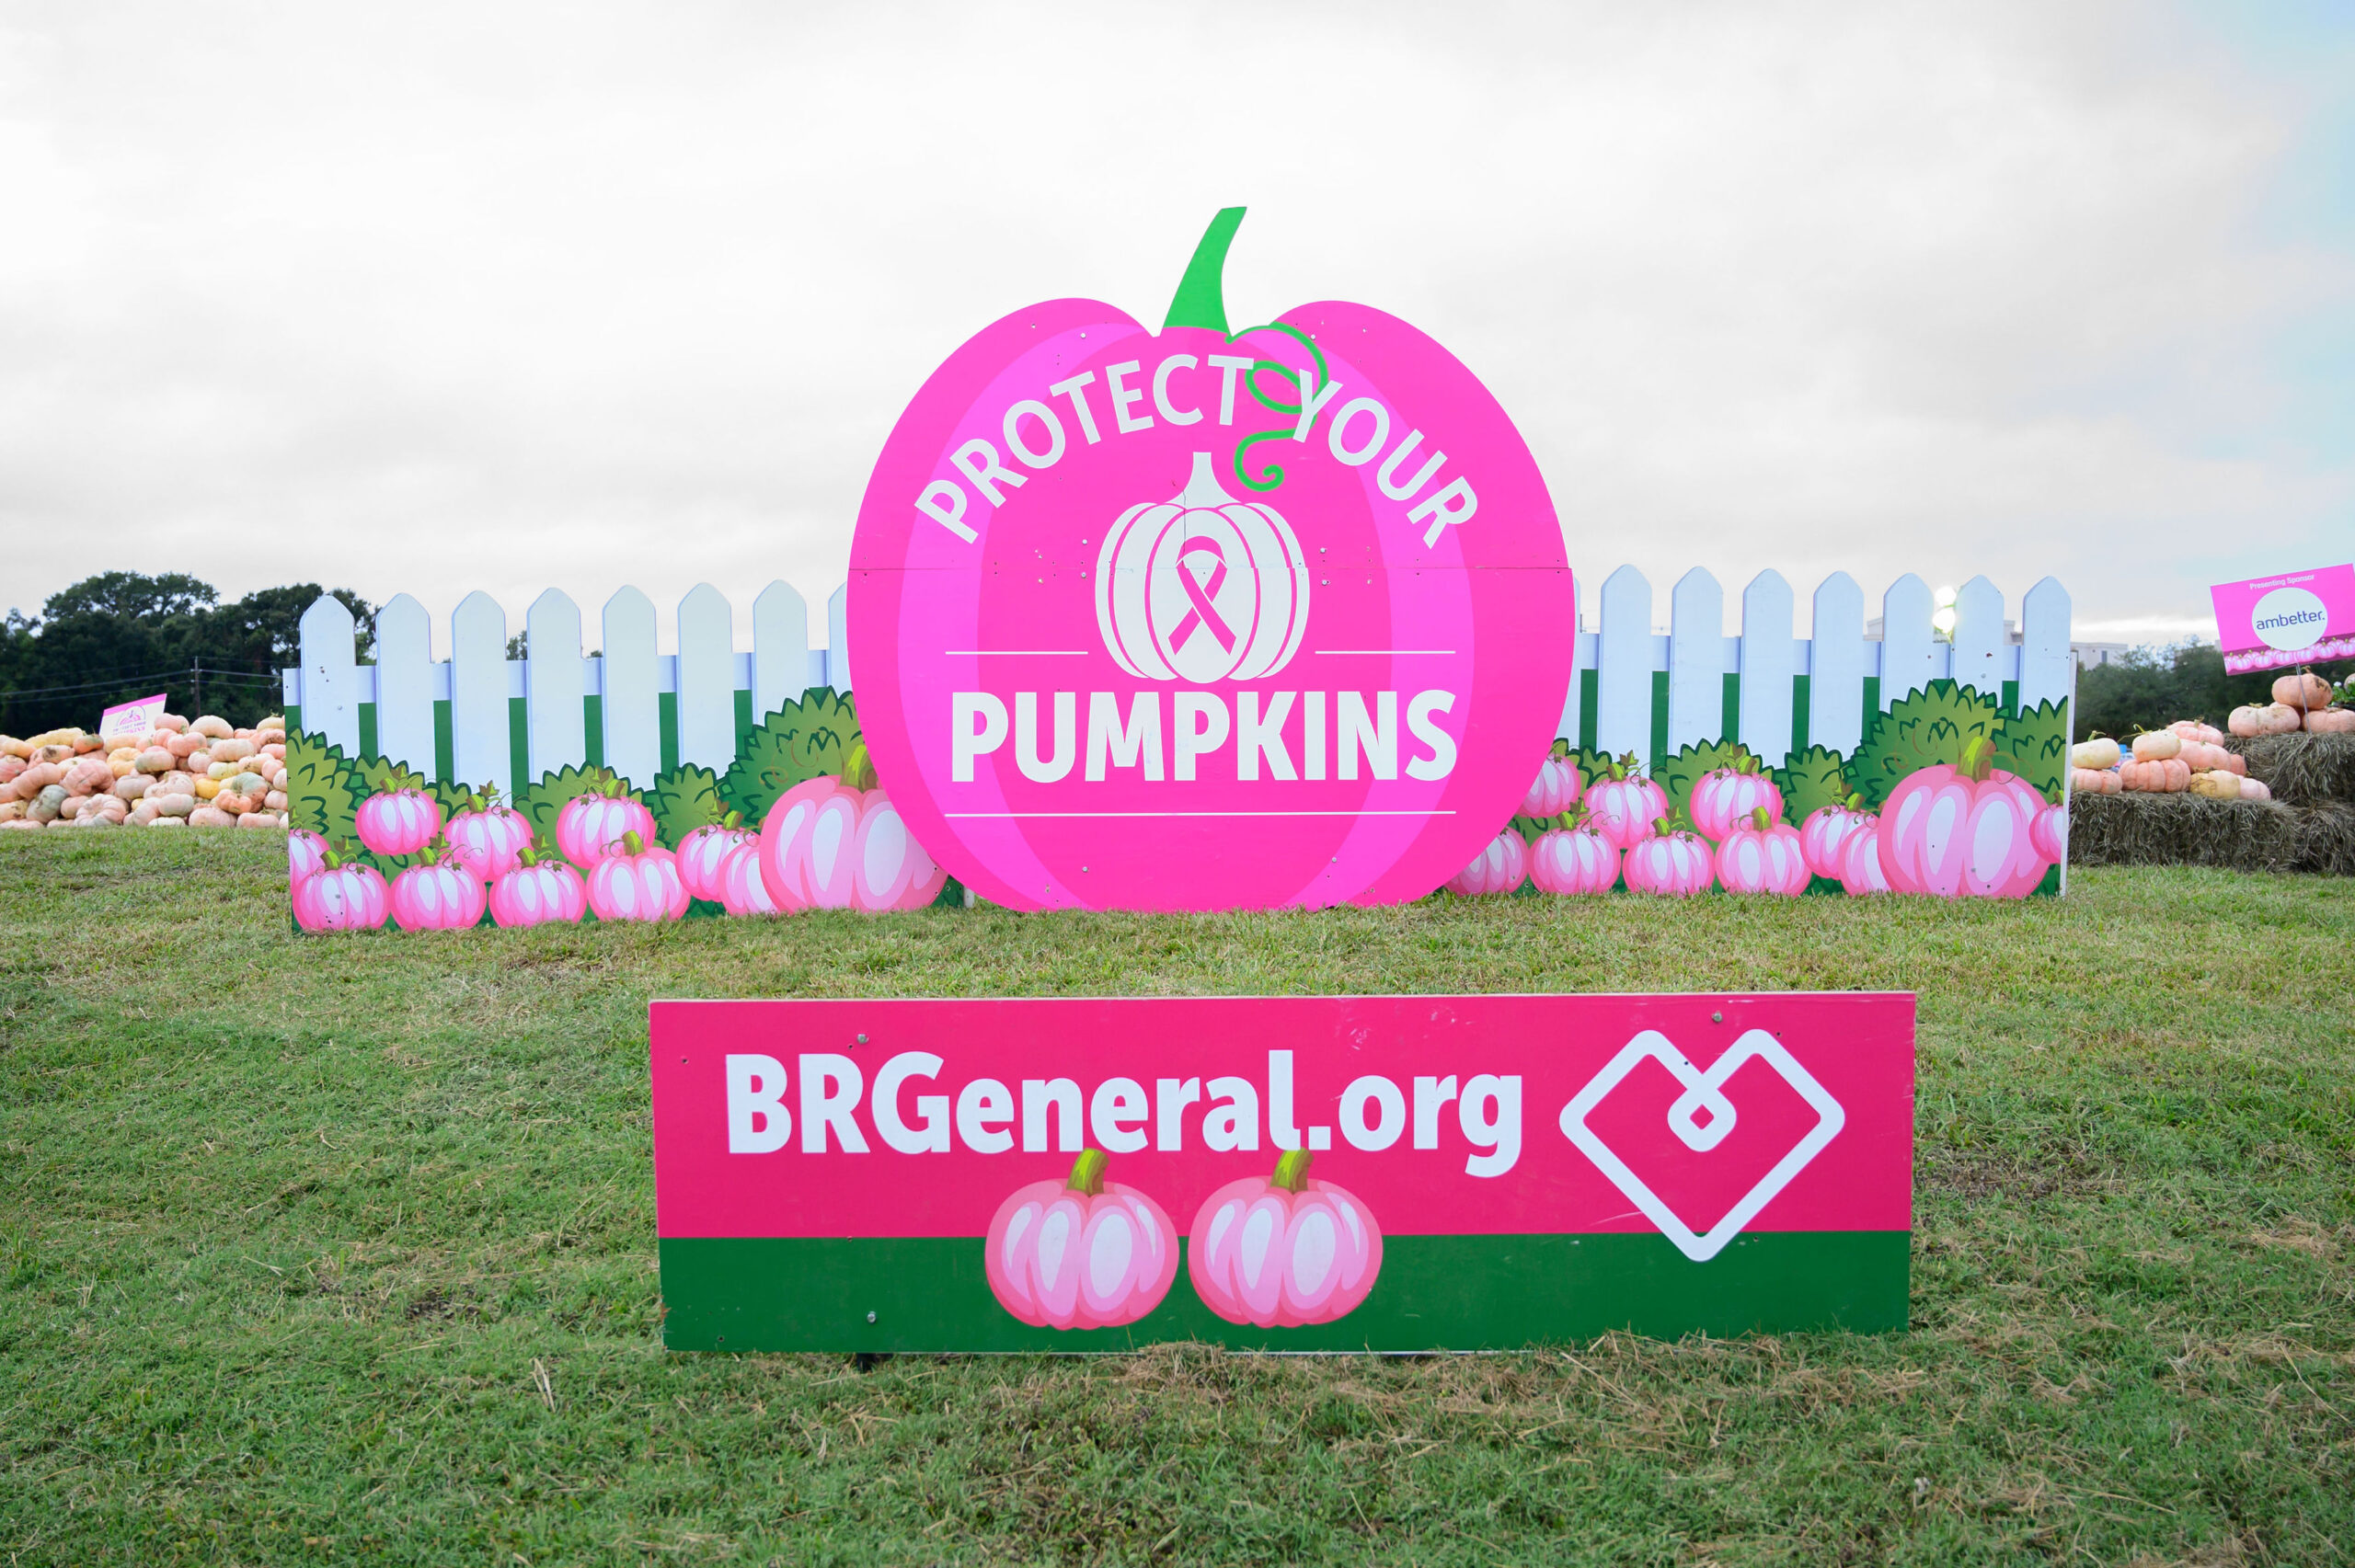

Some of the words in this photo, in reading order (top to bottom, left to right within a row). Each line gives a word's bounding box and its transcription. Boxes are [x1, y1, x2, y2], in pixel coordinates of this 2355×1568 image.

[914, 353, 1255, 544] PROTECT
[1292, 368, 1478, 550] YOUR
[2249, 578, 2286, 589] Presenting
[2287, 574, 2315, 585] Sponsor
[2256, 610, 2326, 630] ambetter.
[951, 690, 1457, 784] PUMPKINS
[727, 1050, 1522, 1180] BRGeneral.org
